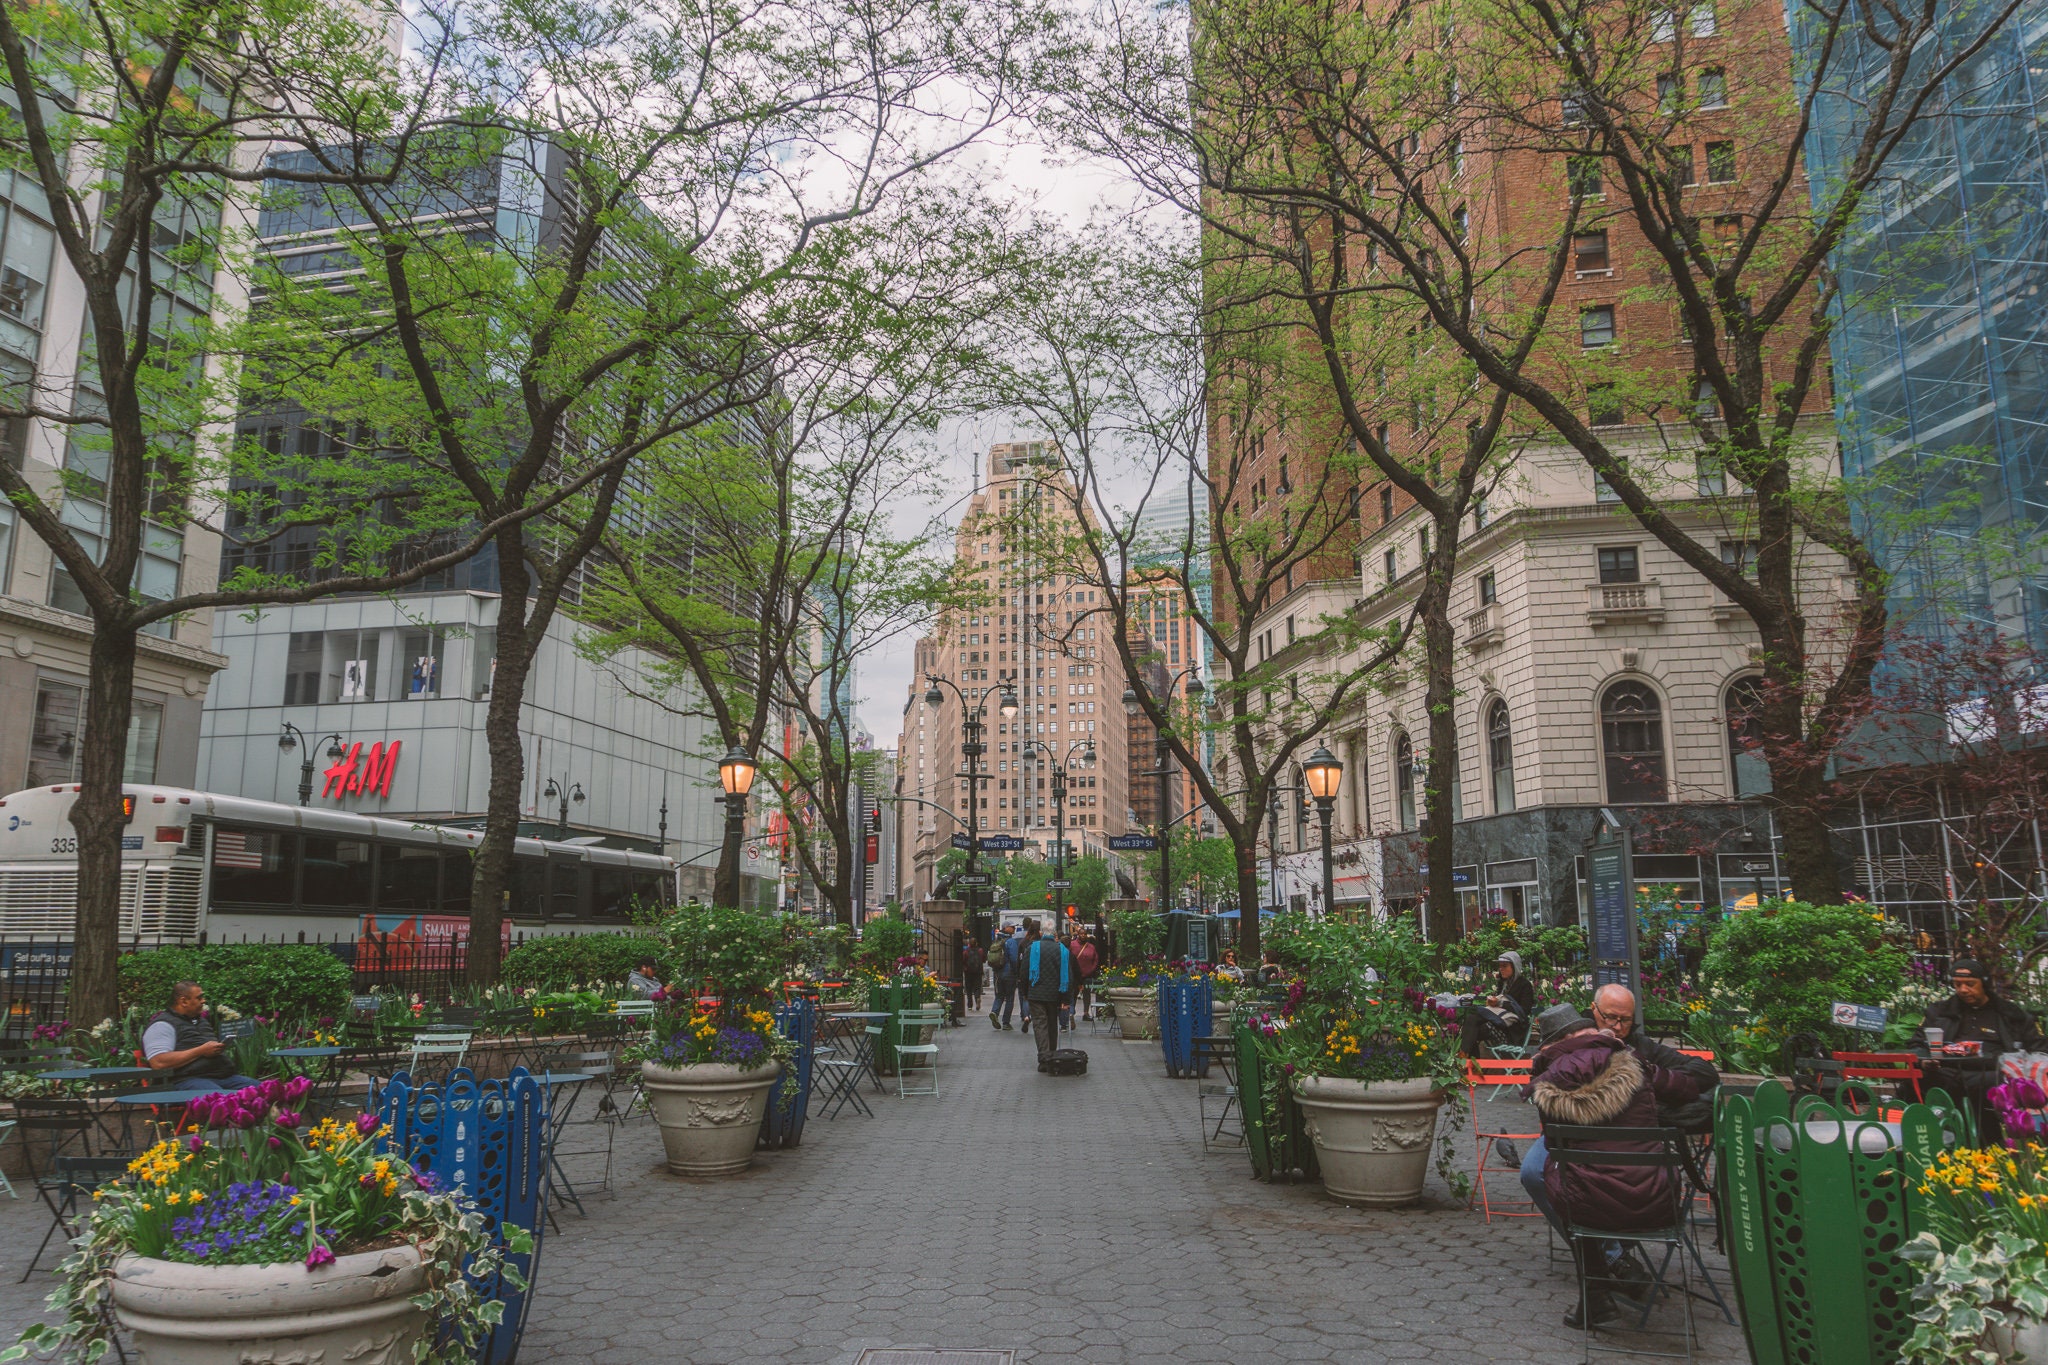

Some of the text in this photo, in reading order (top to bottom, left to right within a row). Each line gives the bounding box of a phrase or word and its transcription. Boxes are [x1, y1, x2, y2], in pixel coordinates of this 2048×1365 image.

[322, 740, 401, 800] H&M
[51, 838, 79, 853] 335
[983, 840, 1020, 848] West 33rd St
[1734, 1115, 1754, 1252] GREELEY SQUARE
